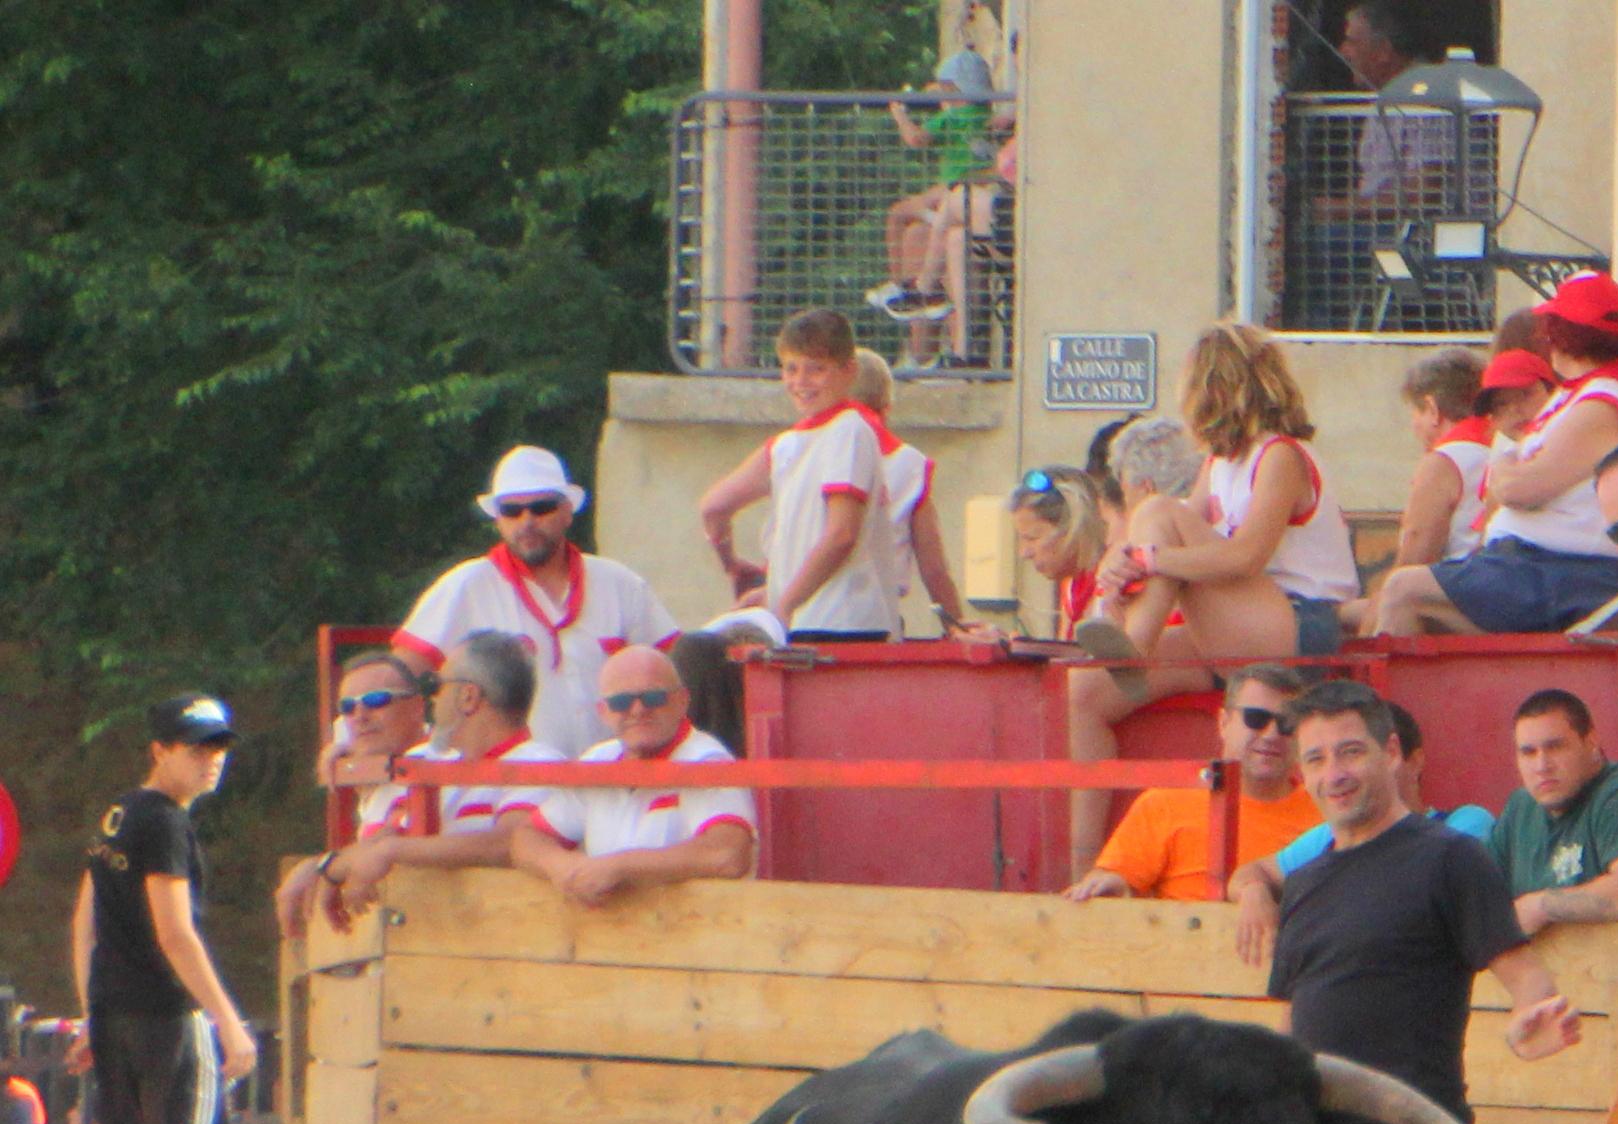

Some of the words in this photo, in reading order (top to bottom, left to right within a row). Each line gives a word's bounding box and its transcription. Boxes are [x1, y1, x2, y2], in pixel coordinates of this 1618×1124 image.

[1072, 338, 1126, 357] CALLE
[1051, 359, 1119, 379] CAMINO
[1123, 362, 1147, 380] DE
[1053, 382, 1075, 400] LA
[1077, 382, 1145, 401] CASTRA
